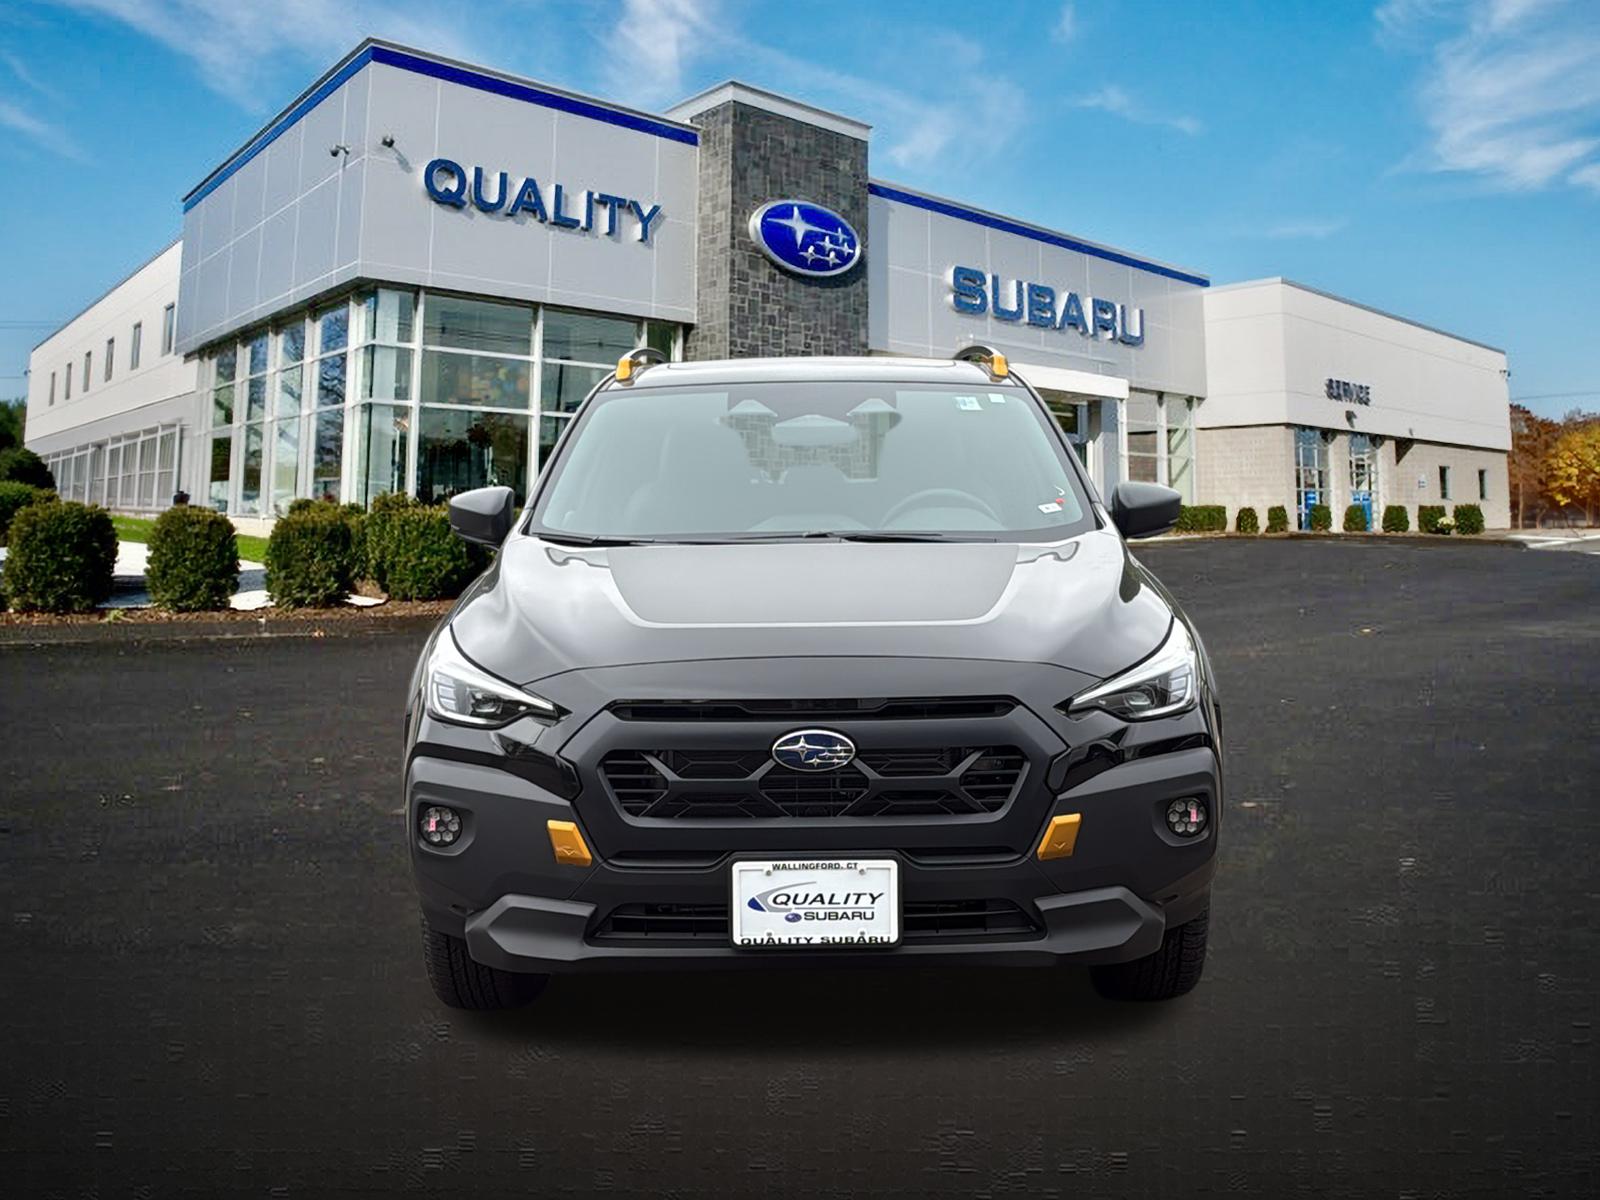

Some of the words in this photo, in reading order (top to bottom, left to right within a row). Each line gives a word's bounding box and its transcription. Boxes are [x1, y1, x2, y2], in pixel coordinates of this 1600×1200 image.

[424, 158, 661, 242] QUALITY
[952, 265, 1145, 347] SUBARU
[846, 862, 859, 870] CT
[772, 893, 884, 906] QUALITY
[804, 911, 875, 921] SUBARU
[740, 937, 814, 945] QUALITY
[820, 936, 891, 944] SUBARU
